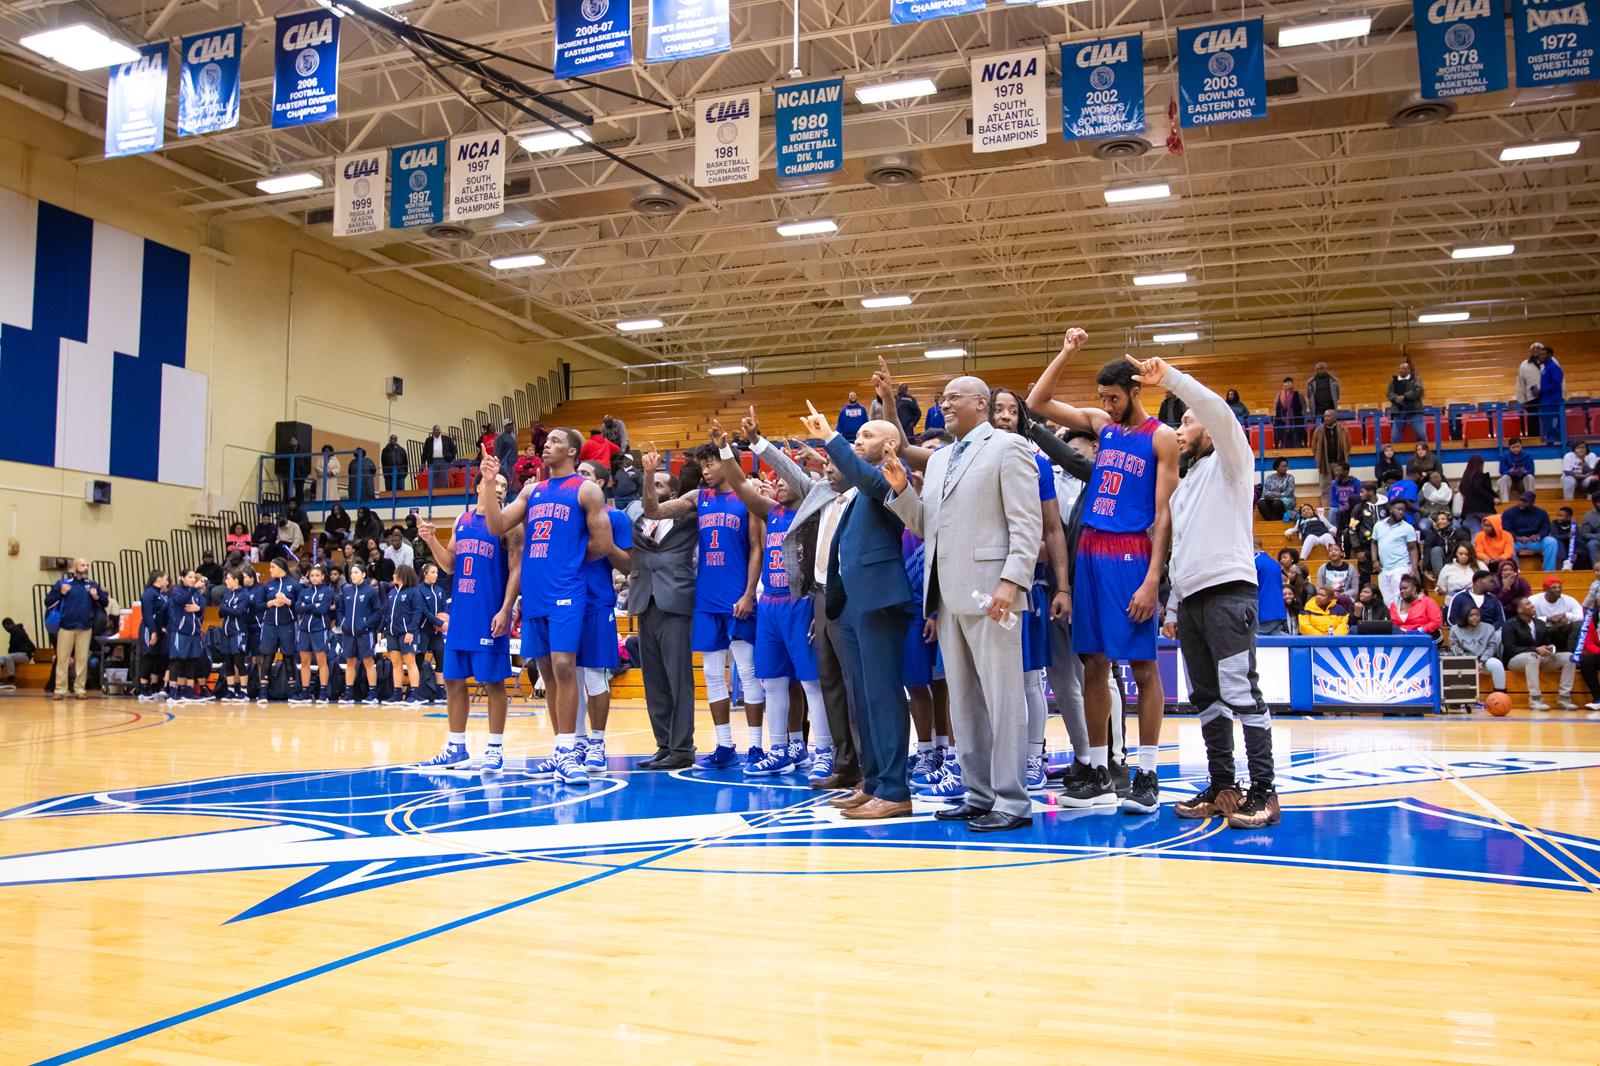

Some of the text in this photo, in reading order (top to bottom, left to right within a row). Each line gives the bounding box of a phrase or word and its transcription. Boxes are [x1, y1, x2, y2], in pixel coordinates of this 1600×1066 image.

[911, 0, 966, 13] CHAMPIONS
[1428, 0, 1491, 24] CIAA
[1526, 2, 1589, 33] NAIA
[282, 18, 333, 51] CIAA
[575, 21, 614, 37] 2006-07
[188, 33, 235, 64] CIAA
[557, 38, 588, 50] WOMEN'S
[1193, 26, 1248, 55] CIAA
[1540, 33, 1578, 50] 1972
[564, 40, 625, 58] EASTERN DIVISION
[1076, 41, 1128, 68] CIAA
[574, 51, 614, 65] CHAMPIONS
[1443, 49, 1478, 66] 1978
[1528, 51, 1571, 64] DISTRICT
[1533, 58, 1590, 72] WRESTLING
[981, 57, 1037, 83] NCAA
[1443, 71, 1479, 81] DIVISION
[1532, 67, 1590, 81] CHAMPIONS
[297, 77, 318, 90] 2006
[994, 82, 1024, 98] 1978
[1203, 75, 1238, 91] 2003
[1435, 78, 1488, 90] BASKETBALL
[1438, 85, 1487, 97] CHAMPIONS
[290, 87, 325, 100] FOOTBALL
[777, 85, 841, 109] NCAIAW
[1086, 89, 1118, 105] 2002
[1198, 88, 1245, 102] BOWLING
[276, 93, 337, 111] EASTERN DIVISION
[993, 99, 1027, 112] SOUTH
[1081, 102, 1125, 115] WOMEN'S
[1188, 97, 1256, 113] EASTERN DIV.
[287, 106, 327, 119] CHAMPIONS
[705, 98, 750, 124] CIAA
[986, 108, 1034, 123] ATLANTIC
[1193, 109, 1252, 124] CHAMPIONS
[791, 113, 828, 131] 1980
[978, 118, 1041, 134] BASKETBALL
[1077, 113, 1128, 126] SOFTBALL
[789, 128, 829, 142] WOMEN'S
[982, 129, 1039, 146] CHAMPIONS
[1075, 122, 1132, 137] CHAMPIONS
[457, 139, 500, 161] NCAA
[714, 146, 738, 159] 1981
[782, 138, 837, 154] BASKETBALL
[400, 147, 438, 170] CIAA
[706, 158, 749, 169] BASKETBALL
[797, 151, 823, 162] DIV. II
[343, 157, 379, 180] CIAA
[467, 160, 490, 173] 1997
[705, 166, 750, 177] TOURNAMENT
[785, 160, 835, 175] CHAMPIONS
[466, 175, 491, 185] SOUTH
[708, 173, 747, 184] CHAMPIONS
[408, 190, 431, 203] 1997
[461, 183, 497, 194] ATLANTIC
[351, 197, 372, 210] 1999
[455, 191, 501, 205] BASKETBALL
[349, 208, 374, 217] REGULAR
[457, 201, 500, 215] CHAMPIONS
[351, 215, 373, 223] SEASON
[402, 212, 436, 221] BASKETBALL
[404, 218, 433, 227] CHAMPIONS
[1124, 453, 1146, 478] CITY
[1098, 470, 1123, 496] 20
[553, 503, 571, 522] CITY
[1092, 497, 1117, 517] STATE
[531, 520, 553, 541] 22
[725, 513, 741, 532] CITY
[709, 529, 719, 549] 1
[478, 540, 495, 559] CITY
[529, 543, 549, 559] STATE
[463, 556, 474, 576] 0
[705, 551, 725, 567] STATE
[457, 578, 476, 594] STATE
[769, 572, 789, 588] STATE
[1354, 652, 1391, 673] GO
[1316, 676, 1432, 698] VIKINGS!
